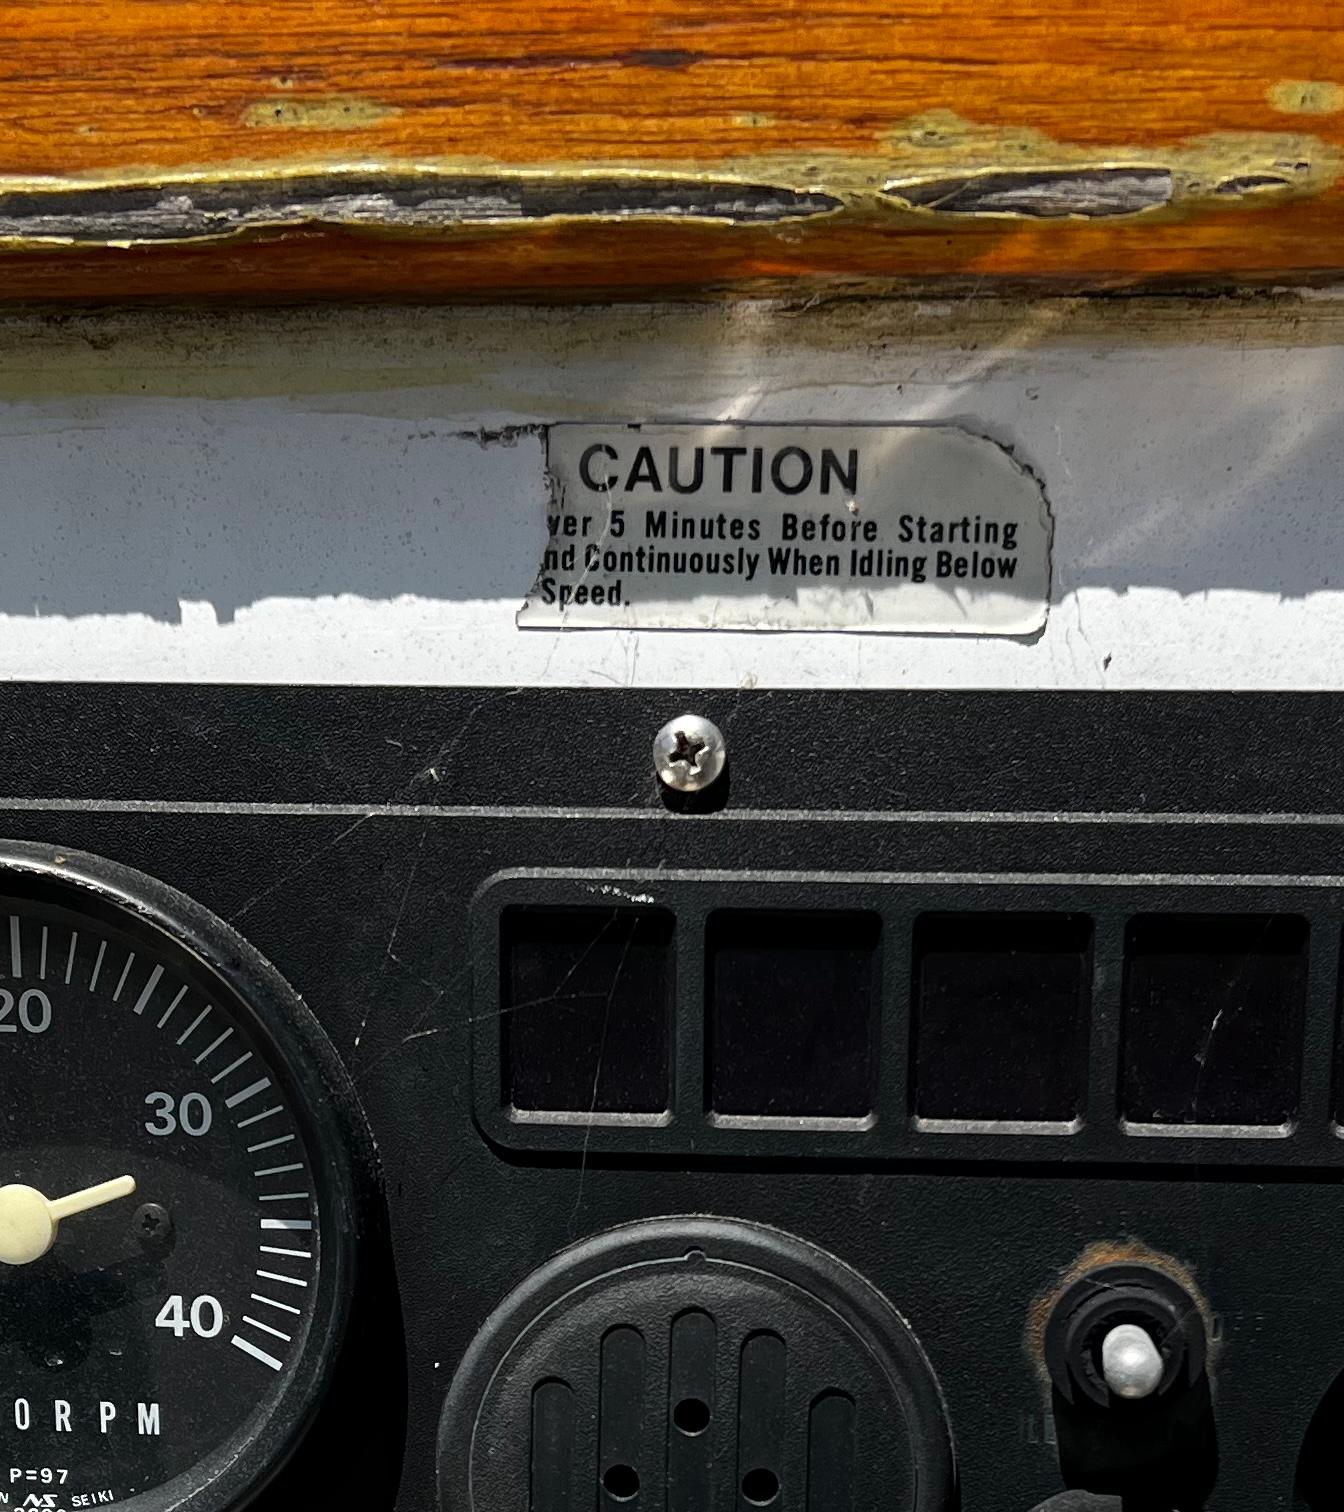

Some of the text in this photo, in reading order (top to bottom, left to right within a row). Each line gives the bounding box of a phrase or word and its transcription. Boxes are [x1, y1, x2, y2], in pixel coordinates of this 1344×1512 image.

[578, 444, 859, 496] CAUTION
[609, 510, 625, 538] 5
[645, 511, 761, 541] Minutes
[782, 513, 878, 543] Before
[898, 515, 1019, 549] Starting
[584, 545, 758, 581] Continuously
[768, 548, 840, 577] When
[850, 549, 927, 583] Idling
[935, 551, 1018, 579] Below
[541, 579, 632, 609] Speed.
[144, 1092, 213, 1137] 30
[154, 1294, 224, 1338] 40
[8, 1466, 69, 1485] P=97
[71, 1489, 115, 1508] SEIKI
